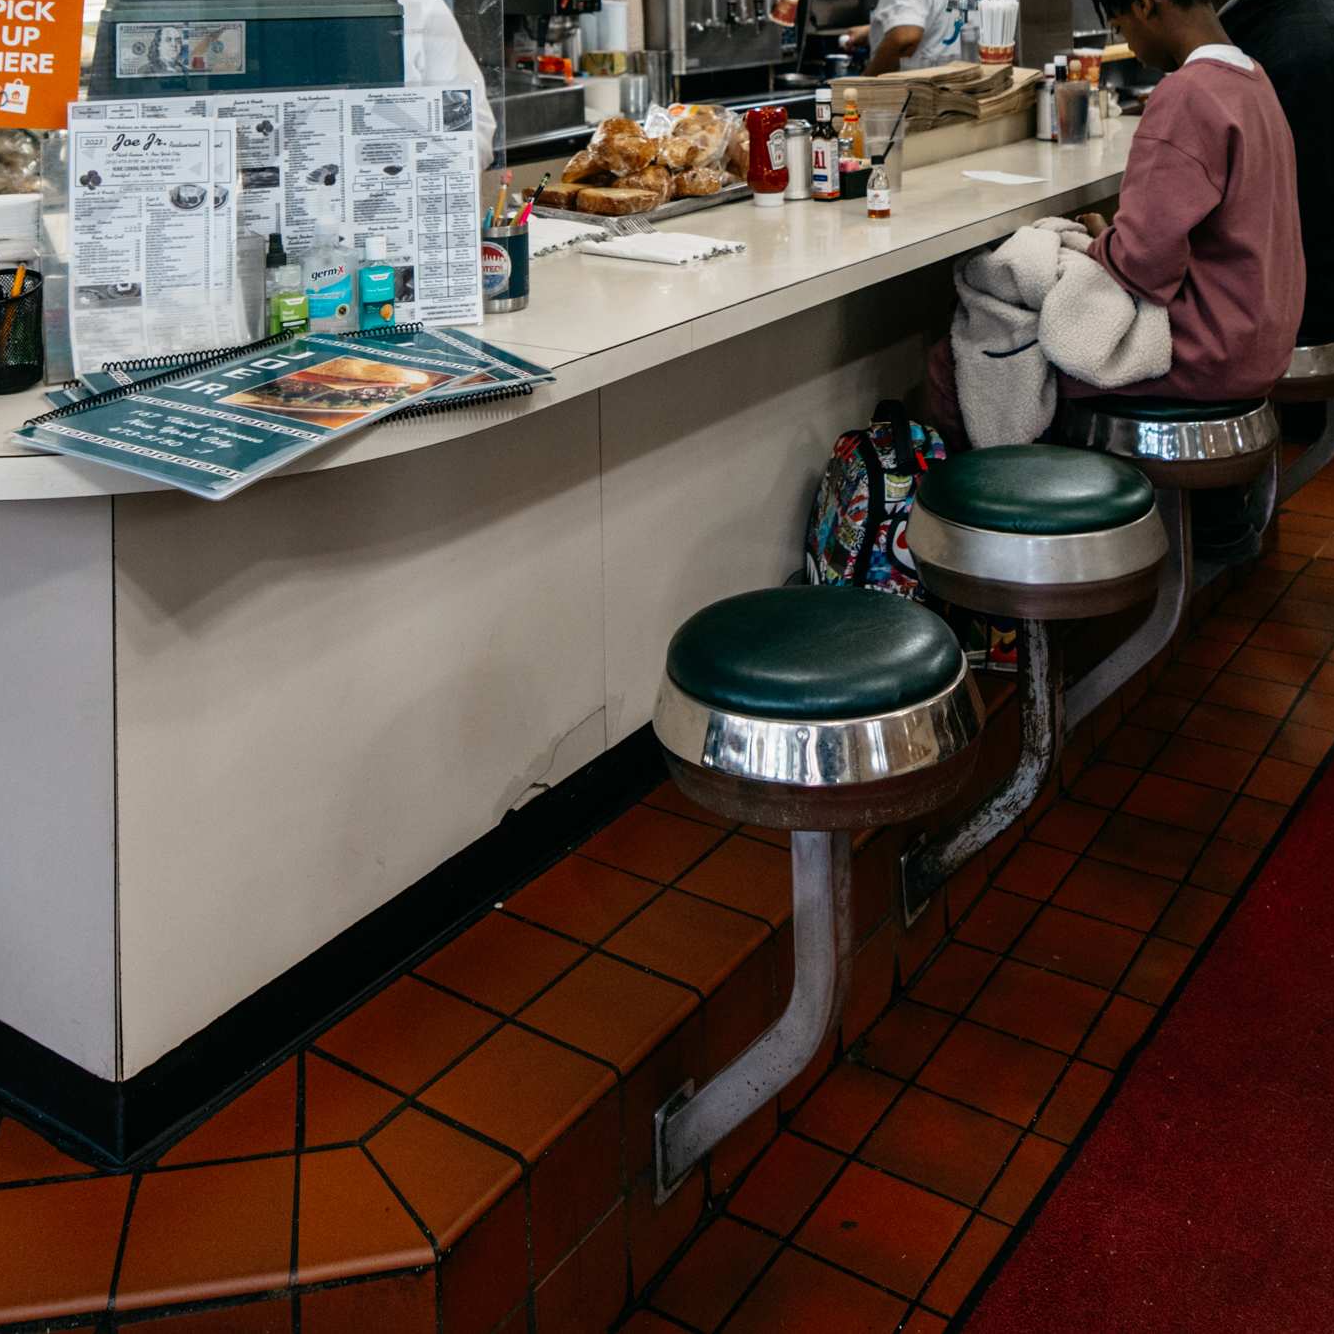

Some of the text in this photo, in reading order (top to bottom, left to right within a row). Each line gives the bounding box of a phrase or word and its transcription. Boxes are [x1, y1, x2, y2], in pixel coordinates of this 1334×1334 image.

[1, 25, 41, 47] UP
[111, 133, 141, 152] Joe
[142, 132, 167, 151] Jr.
[164, 379, 229, 397] JR.
[123, 418, 234, 449] New York City
[206, 427, 265, 444] Avenue
